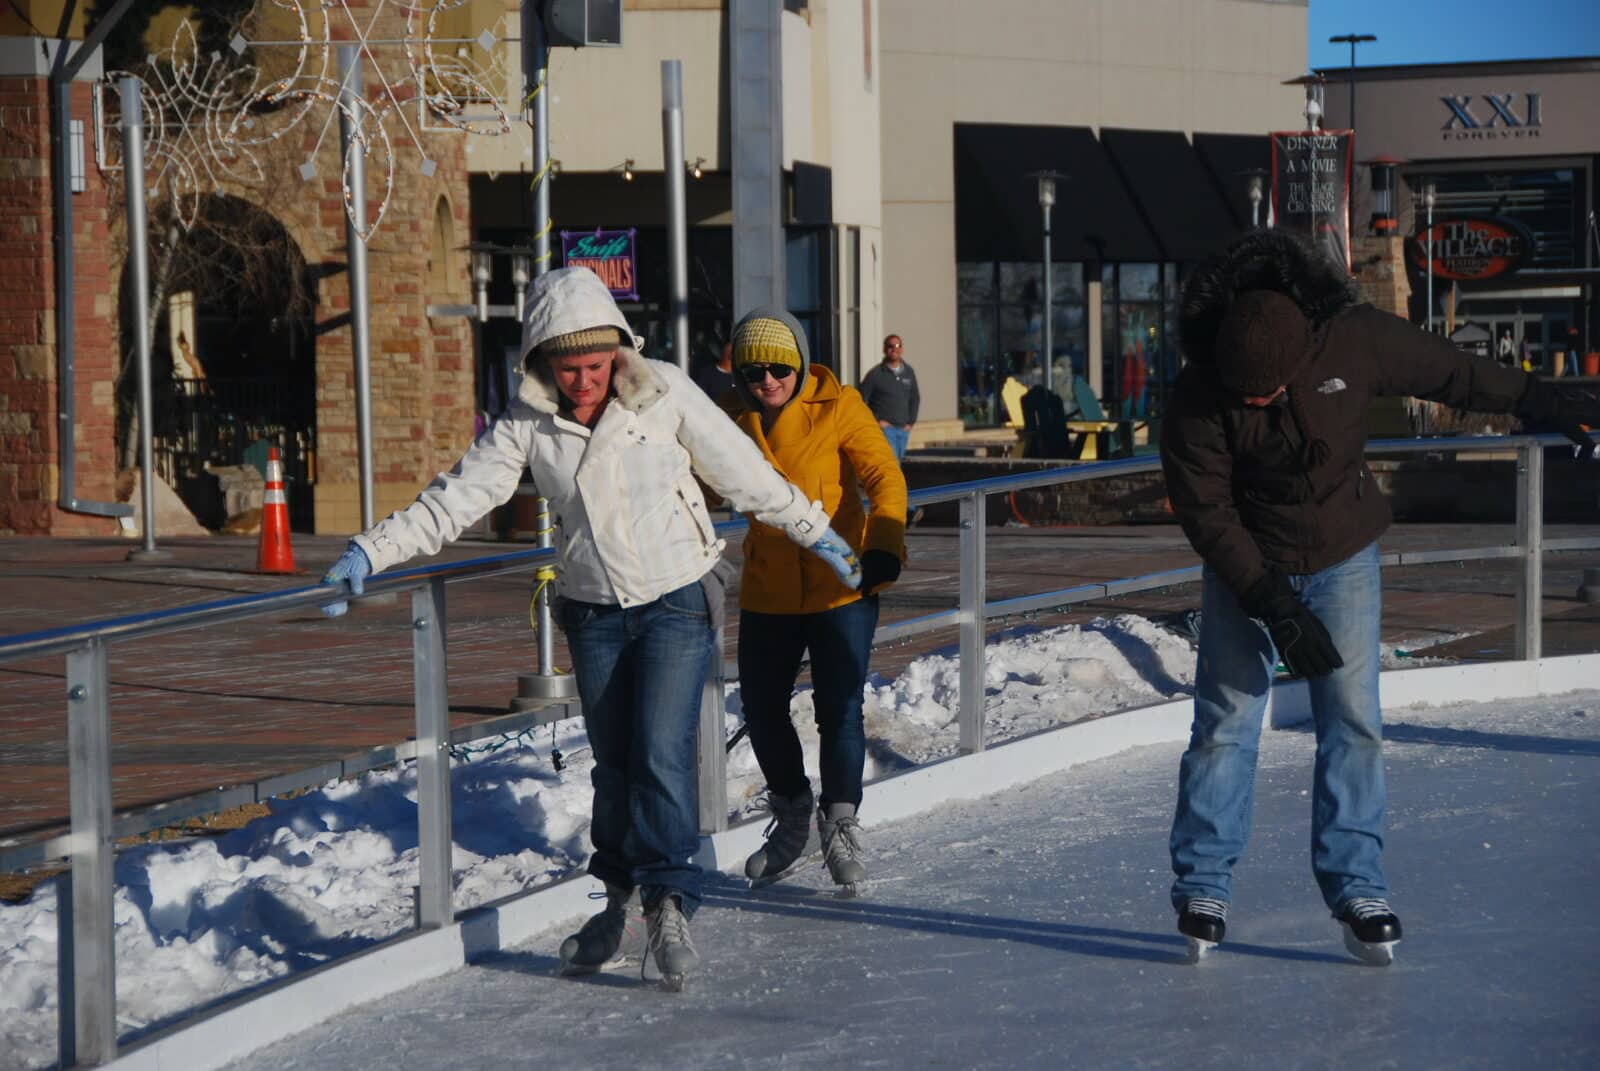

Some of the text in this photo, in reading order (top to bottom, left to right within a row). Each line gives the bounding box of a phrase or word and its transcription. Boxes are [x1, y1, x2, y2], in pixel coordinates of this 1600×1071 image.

[1440, 92, 1542, 129] XXI
[1287, 136, 1337, 151] DINNER
[1442, 130, 1541, 141] FOREVER
[1286, 158, 1337, 174] A MOVIE
[1445, 221, 1489, 247] The
[567, 235, 628, 260] Swift
[1420, 236, 1521, 258] VILLAGE
[567, 258, 632, 289] INALS
